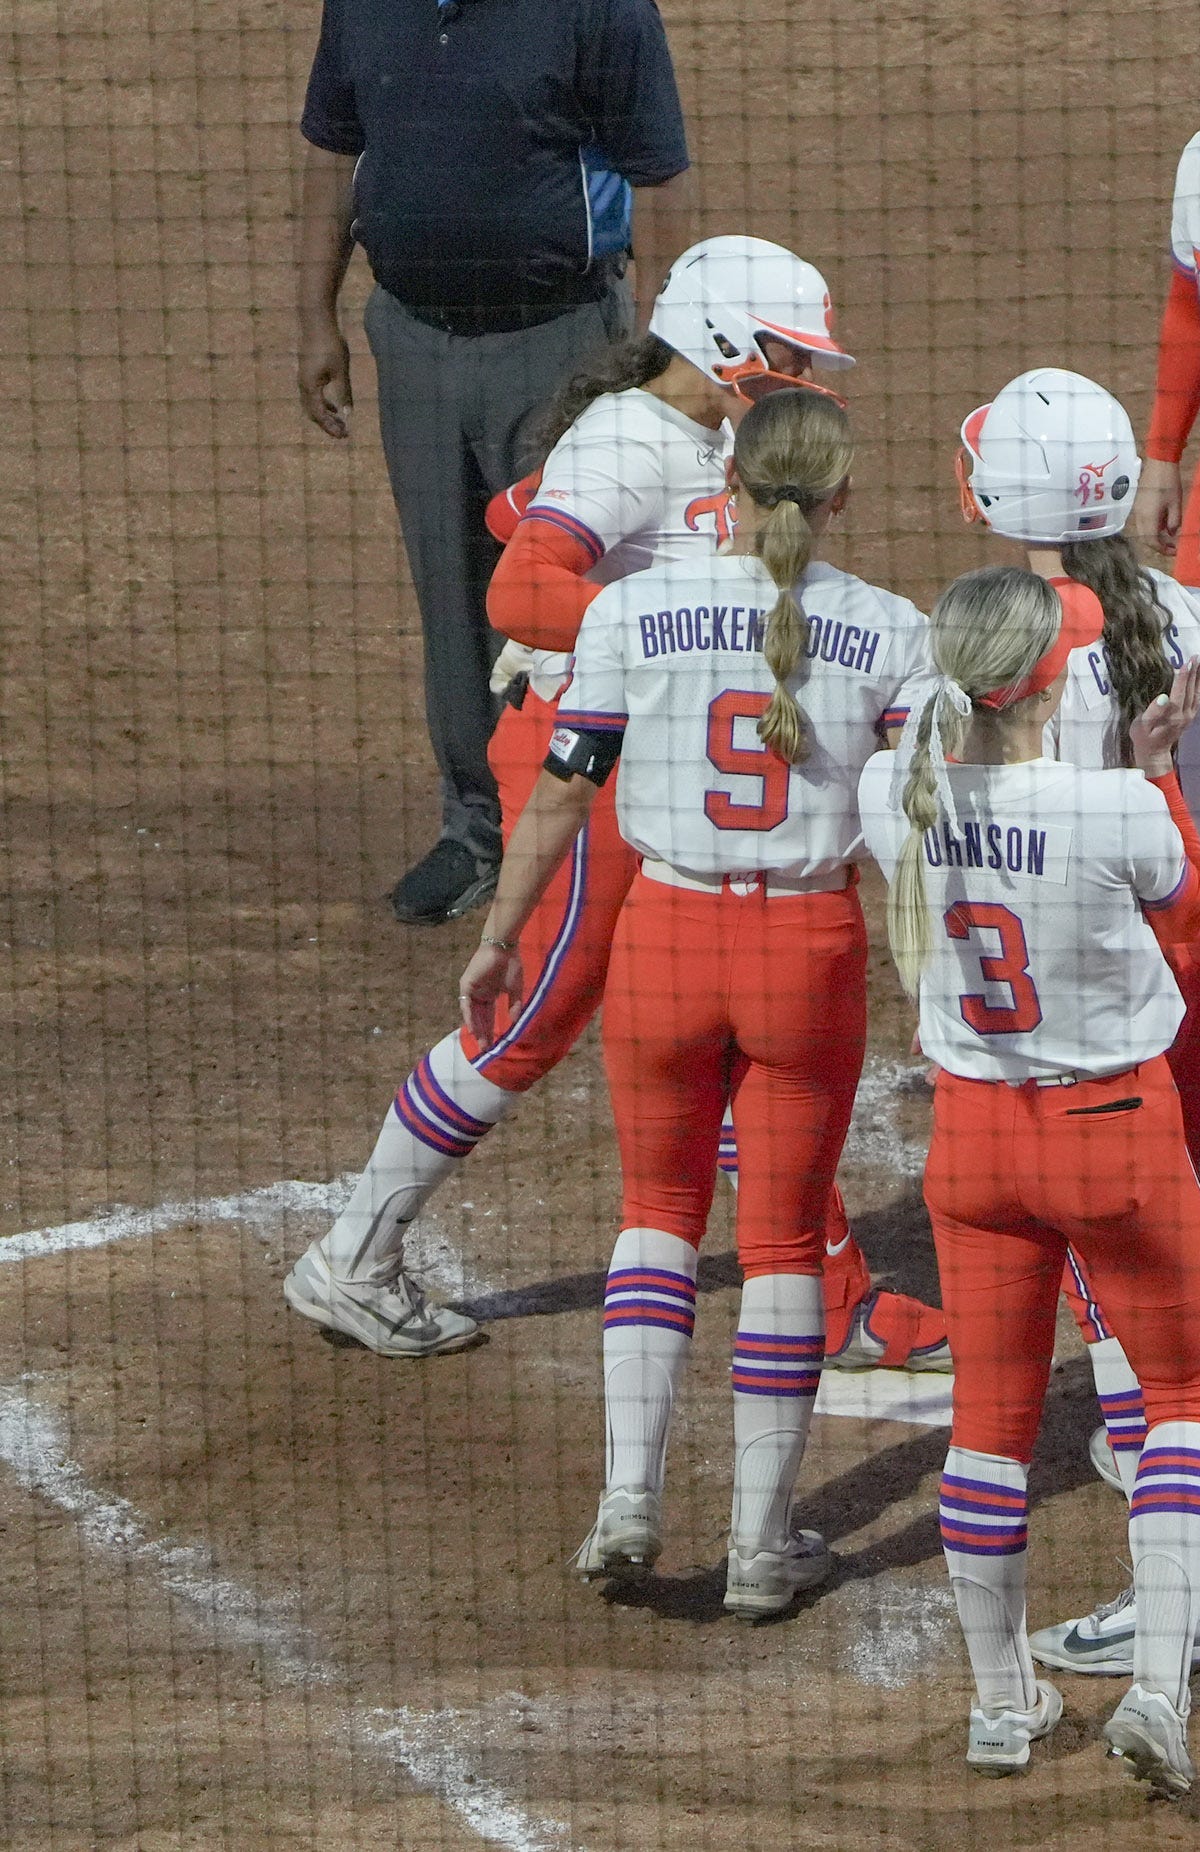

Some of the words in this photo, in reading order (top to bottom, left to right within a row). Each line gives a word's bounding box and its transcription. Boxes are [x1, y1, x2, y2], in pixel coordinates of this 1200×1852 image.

[1094, 482, 1105, 501] 5
[639, 606, 881, 675] BROCKENOUGH
[703, 688, 791, 832] 9
[924, 820, 1047, 876] OHNSON
[943, 900, 1043, 1036] 3
